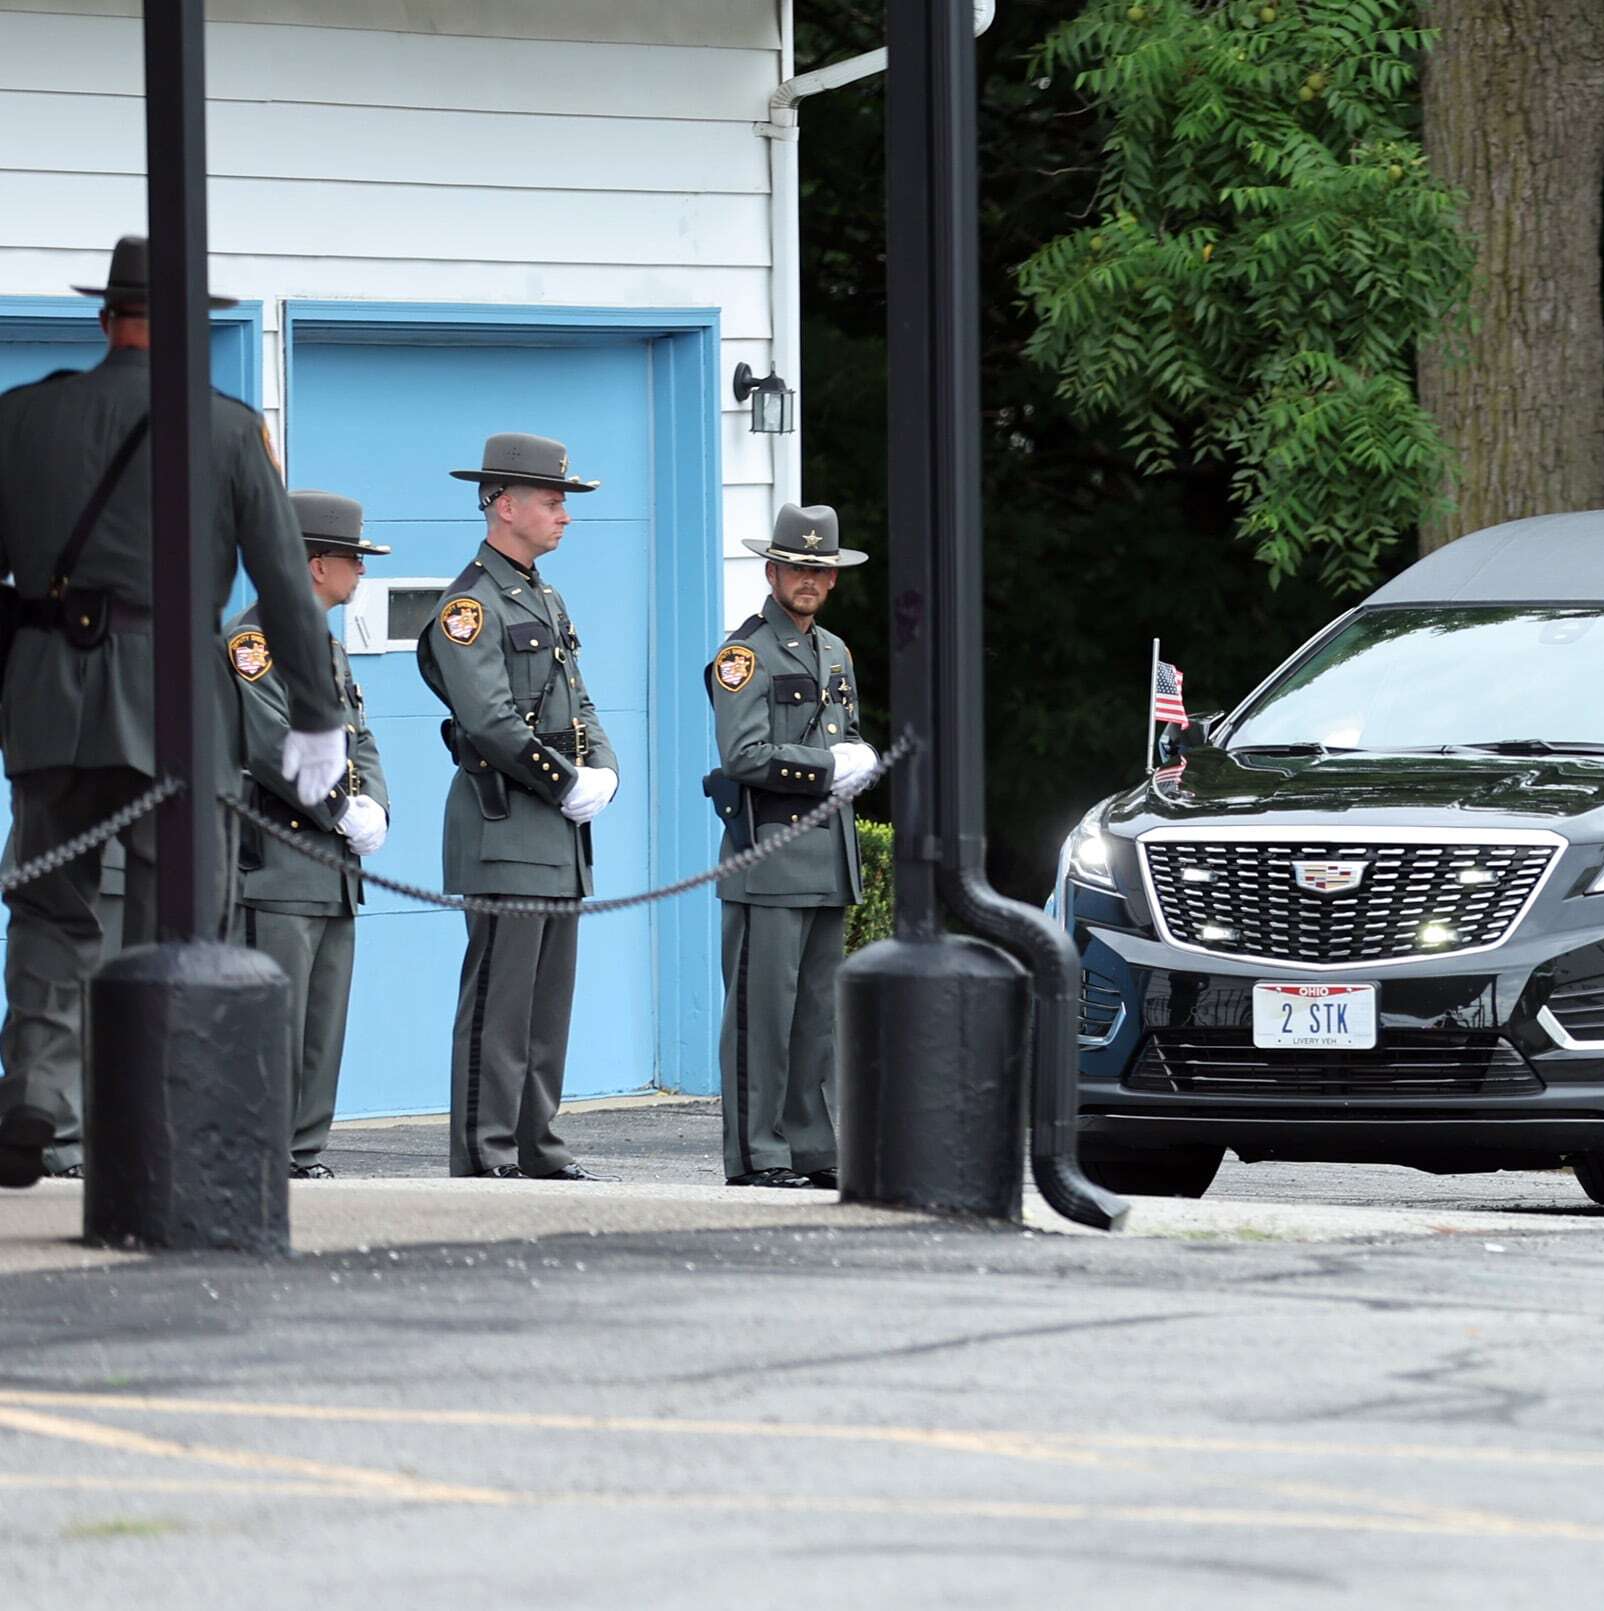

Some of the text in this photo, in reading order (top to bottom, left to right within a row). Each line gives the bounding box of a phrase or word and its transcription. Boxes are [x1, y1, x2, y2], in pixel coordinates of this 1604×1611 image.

[1300, 987, 1329, 996] OHIO
[1282, 1003, 1348, 1033] 2 STK
